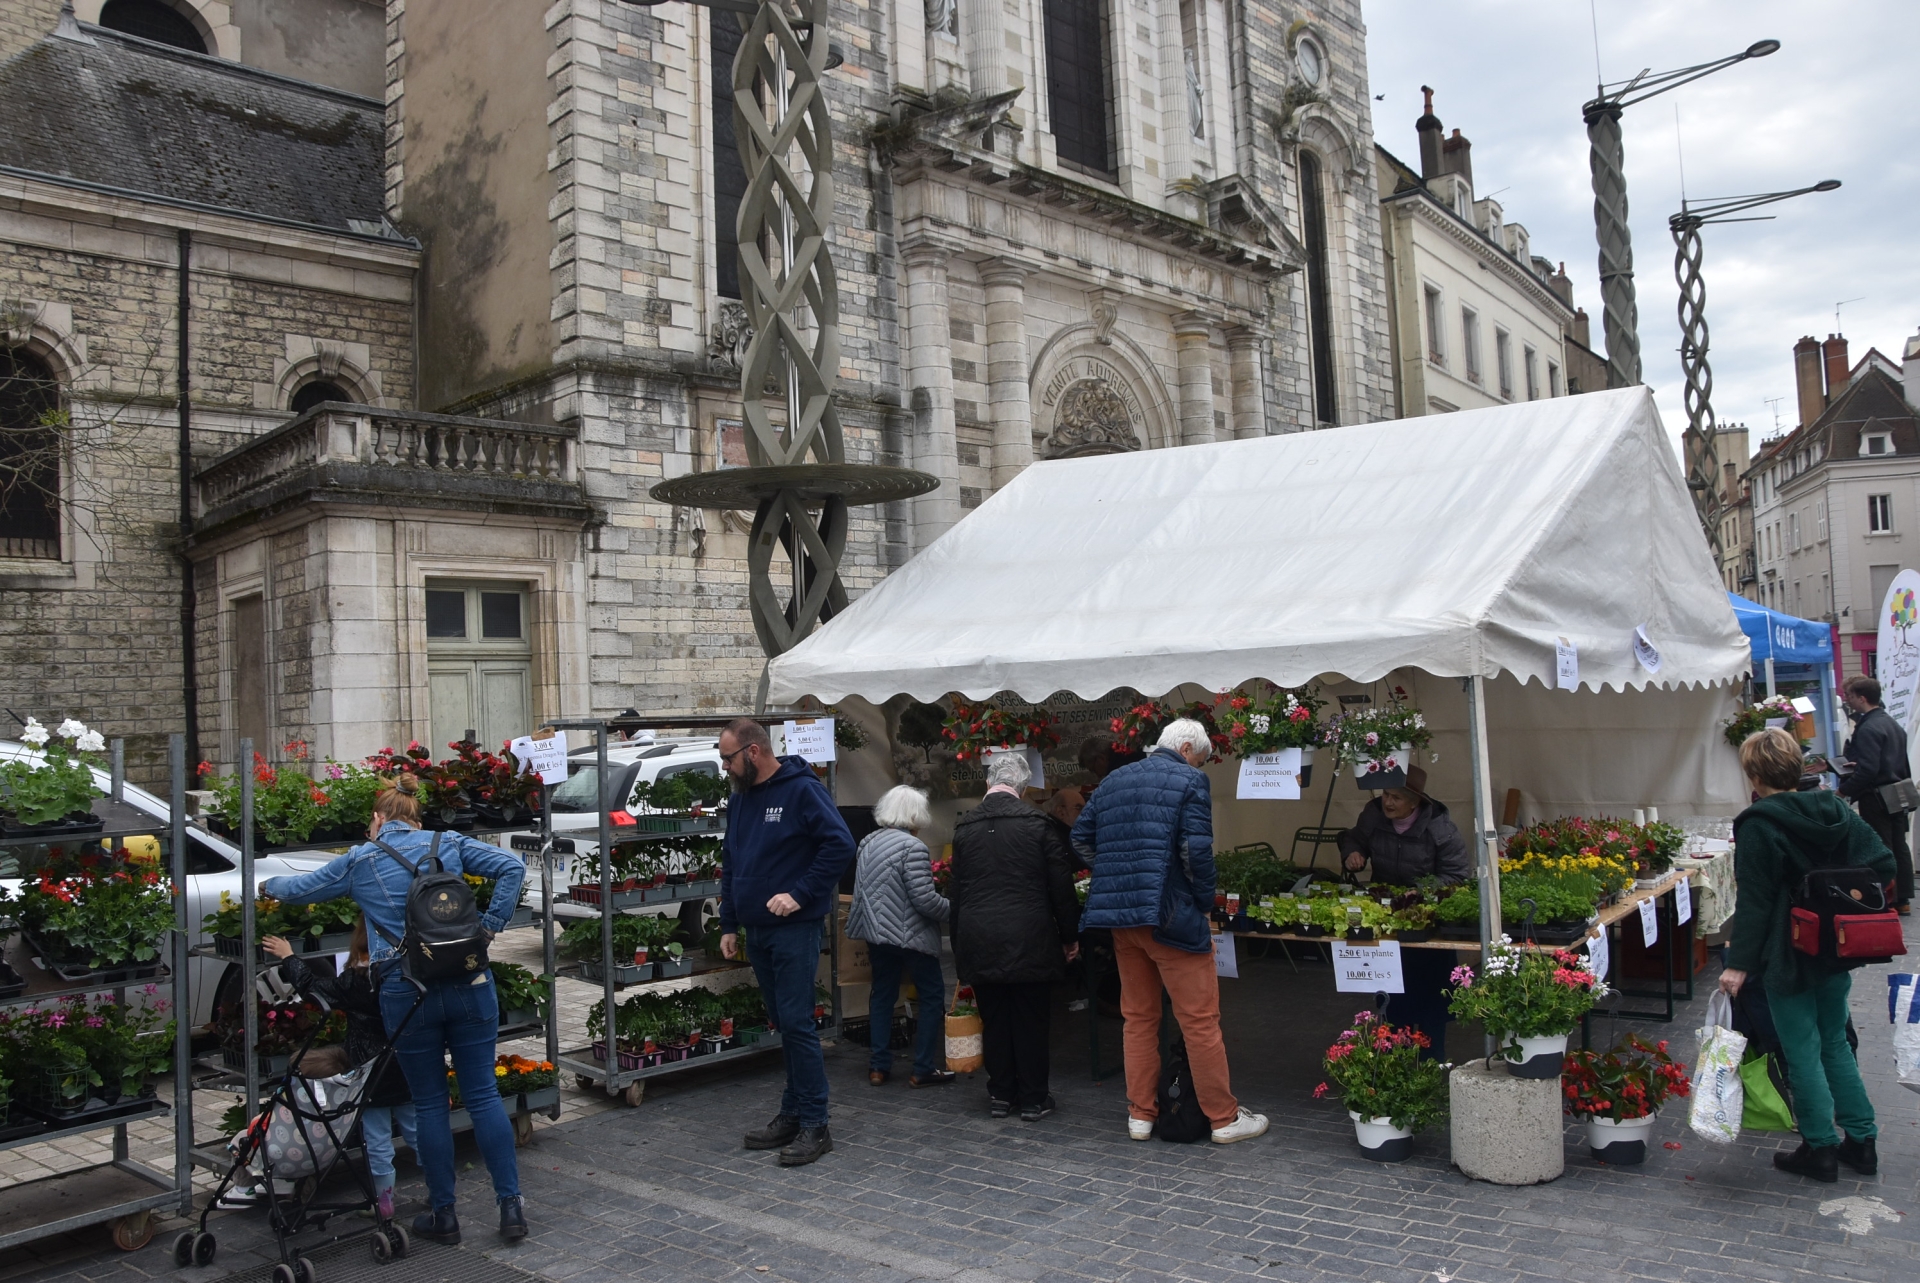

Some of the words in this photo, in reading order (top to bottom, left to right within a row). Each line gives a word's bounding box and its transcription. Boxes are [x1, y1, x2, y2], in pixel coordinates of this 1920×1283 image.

[1043, 362, 1079, 407] VENITE
[1086, 360, 1141, 424] ADOREMUS
[996, 694, 1037, 706] Soci
[1069, 711, 1087, 723] SES
[1254, 768, 1291, 777] suspension
[1339, 950, 1354, 958] 2,50
[1371, 950, 1394, 959] plante
